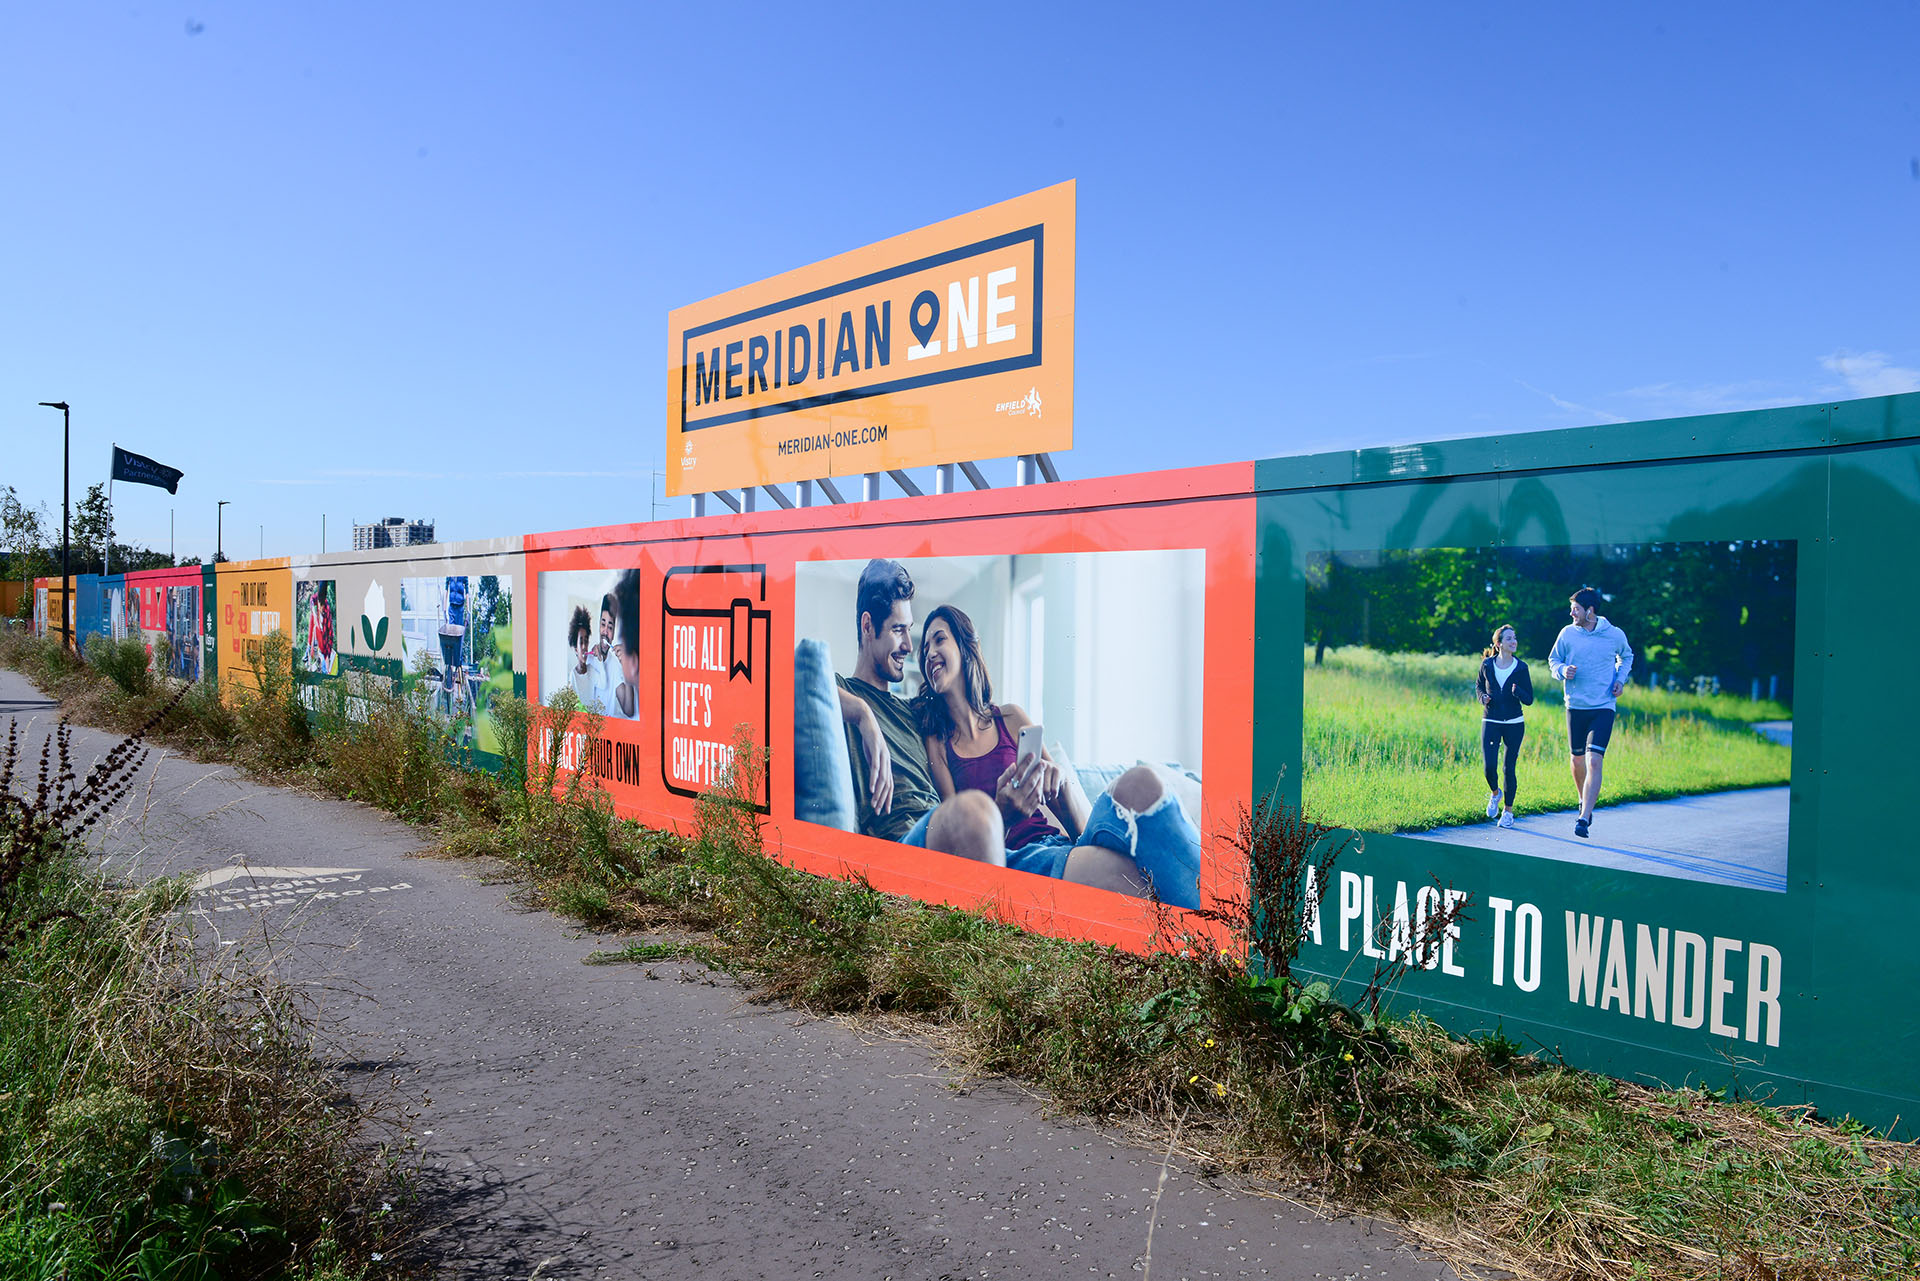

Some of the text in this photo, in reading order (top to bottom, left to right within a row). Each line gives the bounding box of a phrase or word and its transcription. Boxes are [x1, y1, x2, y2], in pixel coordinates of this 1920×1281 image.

[695, 266, 1017, 406] MERIDIAN ONE
[995, 400, 1026, 412] ENFIELD
[778, 425, 888, 456] MERIDIAN-ONE.COM
[673, 625, 726, 671] FOR ALL
[673, 681, 712, 728] LIFE'S
[616, 741, 640, 786] OWN
[221, 887, 319, 903] Lane
[314, 882, 414, 900] Road
[1301, 865, 1783, 1048] A PLACE TO WANDER
